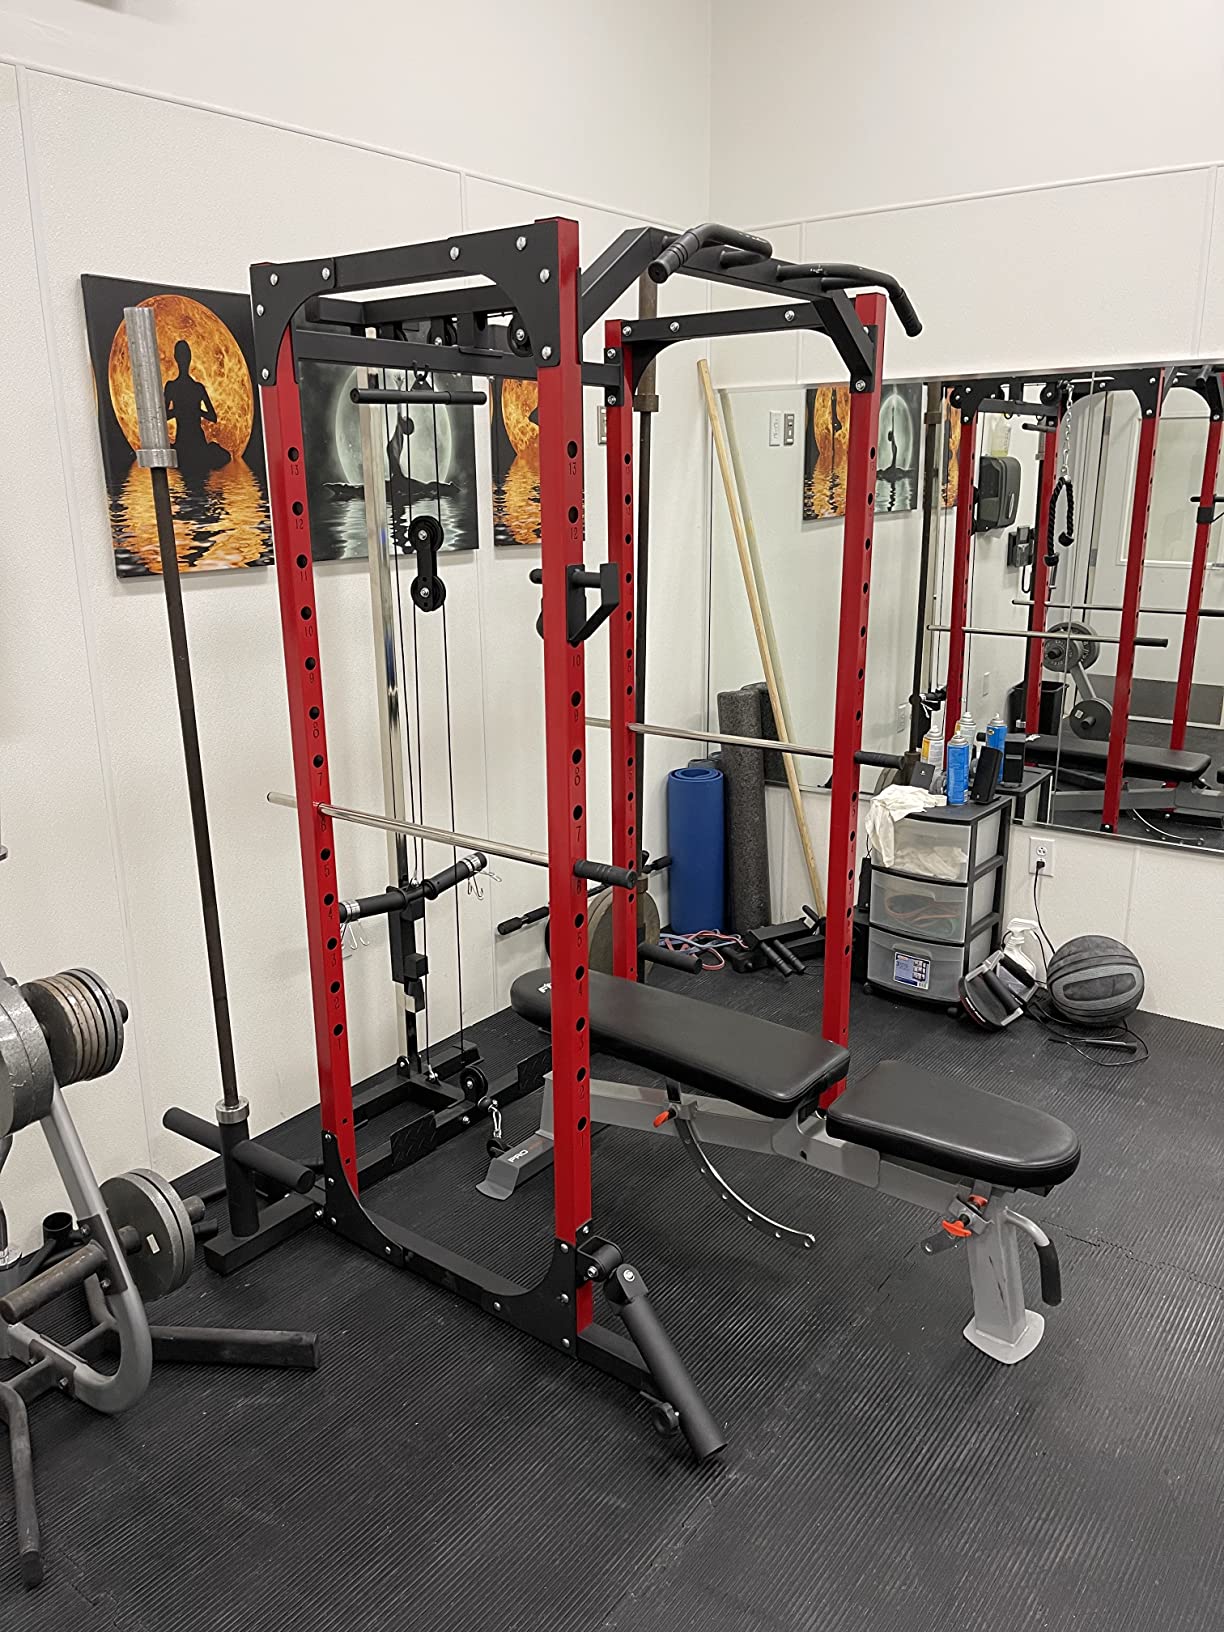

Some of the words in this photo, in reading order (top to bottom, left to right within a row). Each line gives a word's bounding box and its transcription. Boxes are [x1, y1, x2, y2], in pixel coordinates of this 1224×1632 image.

[290, 464, 300, 476] 13
[568, 461, 577, 476] 13
[295, 518, 304, 530] 12
[570, 526, 578, 540] 12
[304, 625, 314, 637] 10
[572, 654, 581, 667] 10
[313, 721, 320, 739] 8
[317, 772, 323, 786] 7
[574, 766, 581, 787] 8
[575, 825, 582, 843] 7
